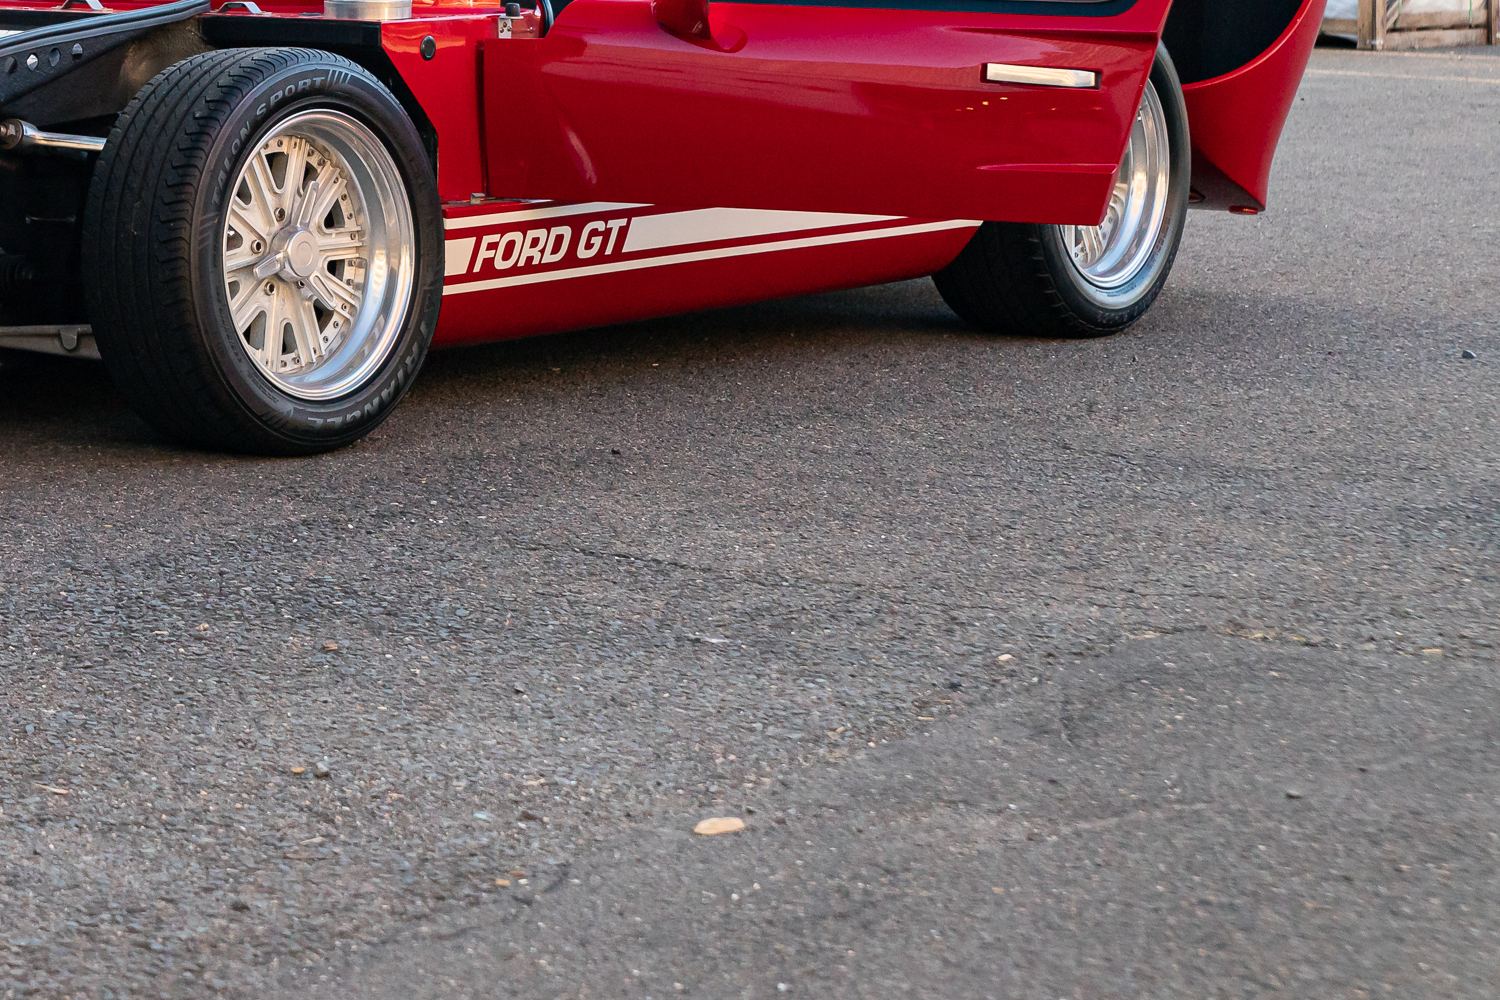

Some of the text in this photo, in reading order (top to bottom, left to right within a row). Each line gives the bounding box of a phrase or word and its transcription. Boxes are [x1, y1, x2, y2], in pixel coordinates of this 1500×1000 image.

[211, 76, 327, 206] TALON SPORT
[472, 218, 628, 273] FORD GT
[307, 319, 430, 427] TRIANGLE
